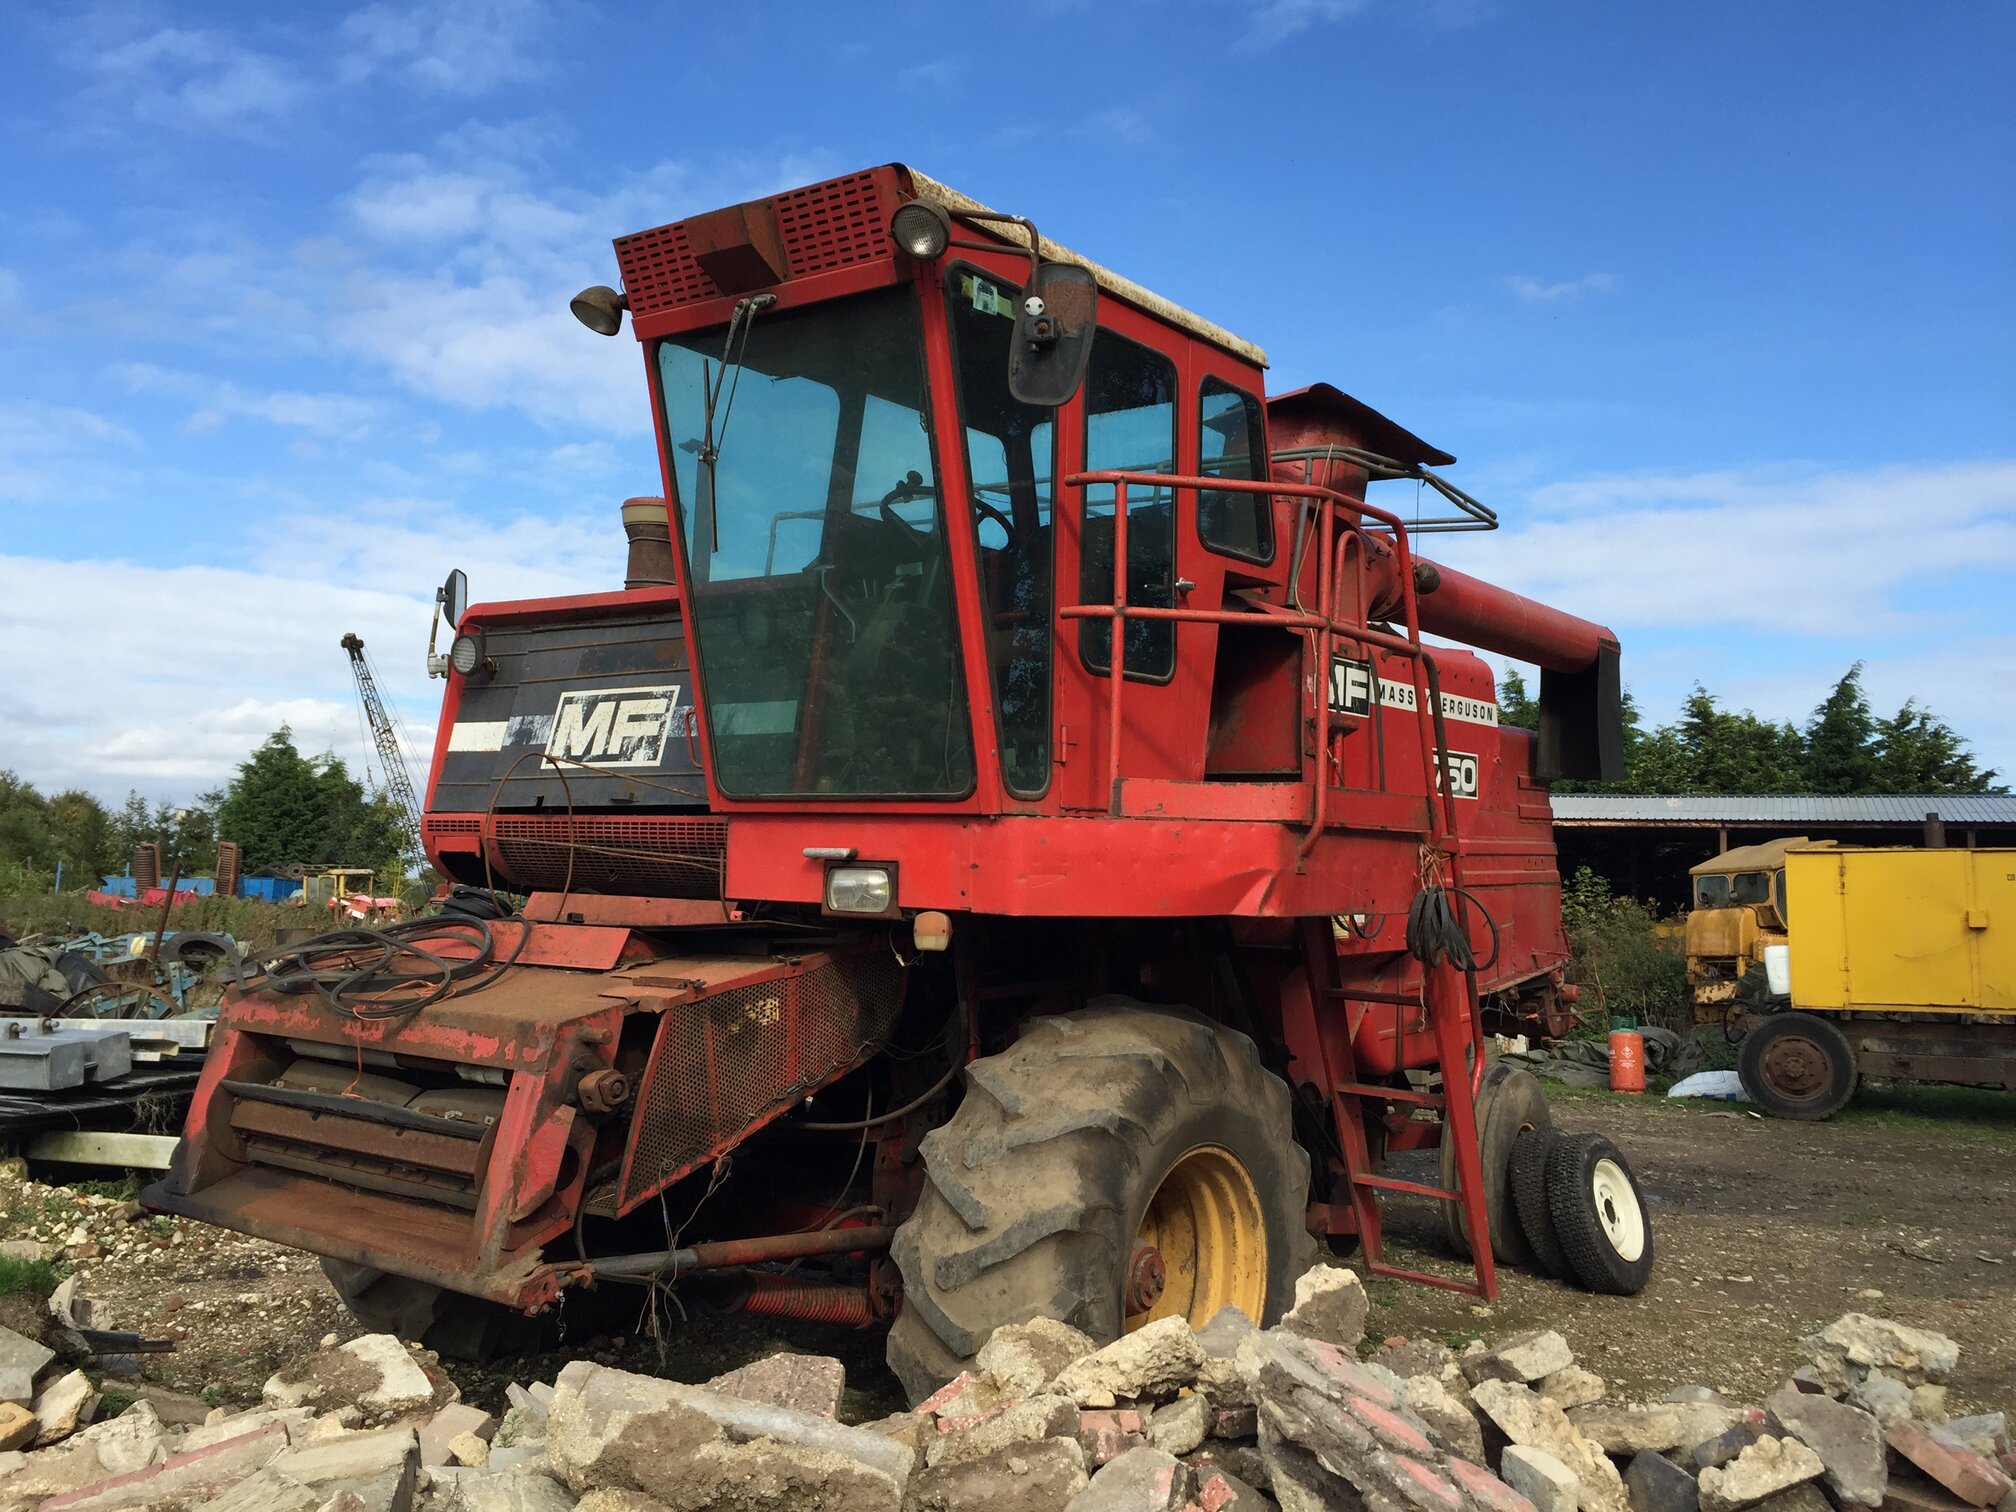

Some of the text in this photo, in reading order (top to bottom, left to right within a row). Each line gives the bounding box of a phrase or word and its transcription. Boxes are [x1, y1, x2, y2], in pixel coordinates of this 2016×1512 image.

[1379, 684, 1493, 721] MASS ERGUSON
[551, 698, 670, 757] MF
